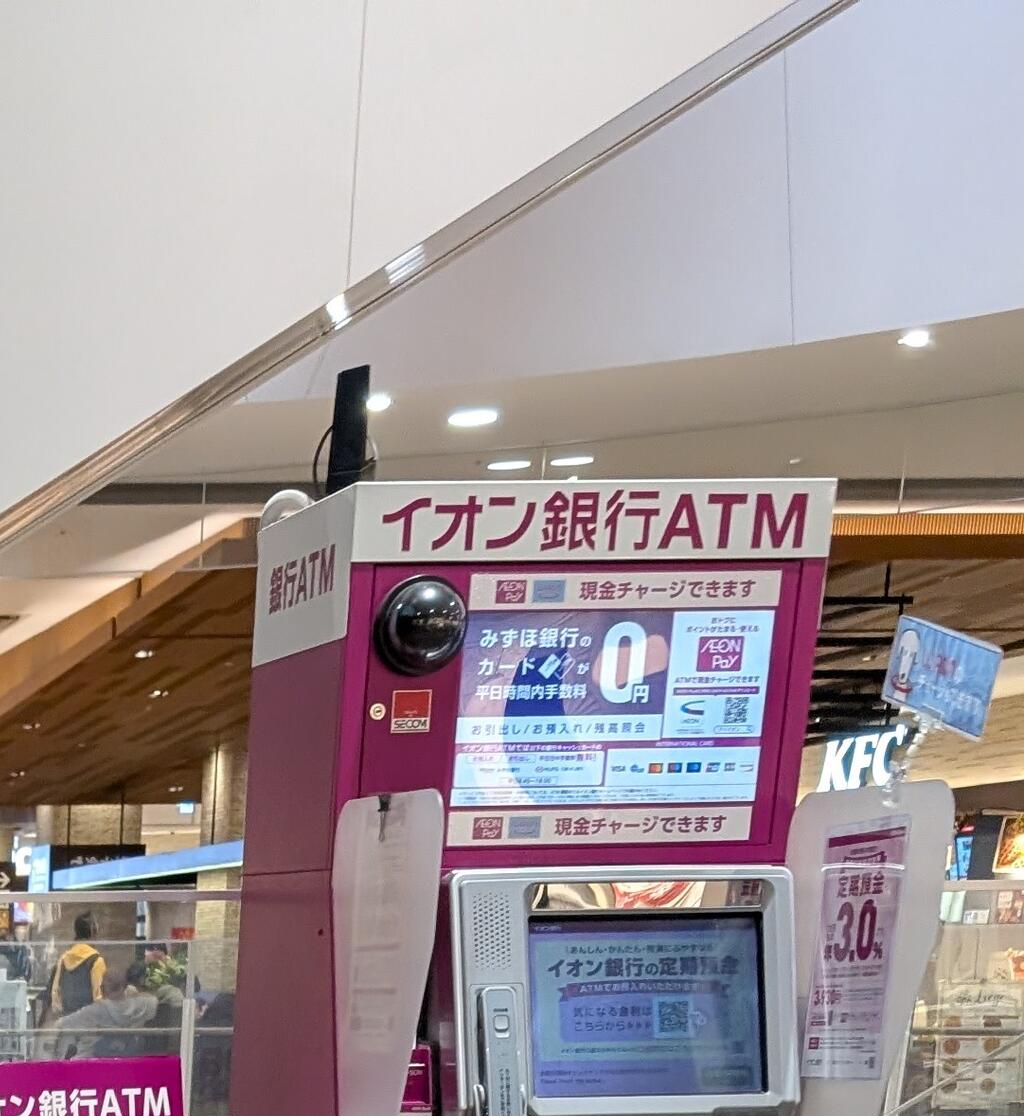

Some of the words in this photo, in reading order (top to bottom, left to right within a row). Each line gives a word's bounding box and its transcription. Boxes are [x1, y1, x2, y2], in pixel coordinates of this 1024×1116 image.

[381, 489, 809, 553] イオン銀行ATM
[268, 543, 336, 616] 銀行ATM
[579, 579, 757, 600] 現金チャージできます
[479, 627, 593, 648] みずほ銀行の
[478, 656, 535, 676] カード
[576, 662, 590, 675] が
[600, 621, 647, 704] 0
[631, 685, 649, 704] 円
[475, 683, 587, 701] 平日時間内手数料
[393, 719, 427, 729] SECOM
[816, 722, 909, 793] KFC
[554, 815, 727, 836] 現金チャージできます
[547, 955, 740, 978] イオン銀行の定期預金
